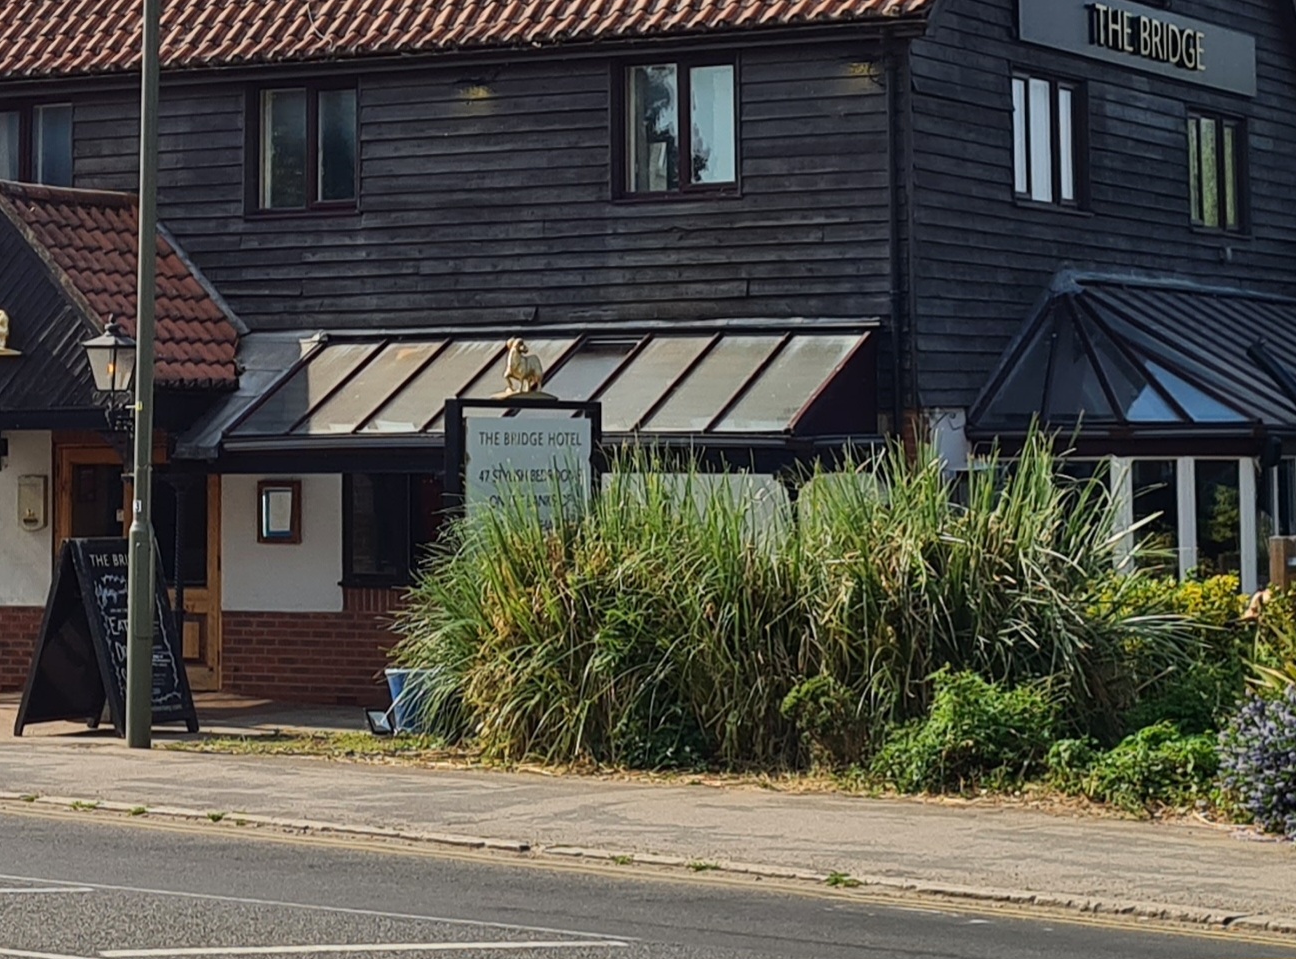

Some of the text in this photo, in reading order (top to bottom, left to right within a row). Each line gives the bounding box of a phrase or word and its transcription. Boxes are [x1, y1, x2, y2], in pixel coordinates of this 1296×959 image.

[1094, 2, 1206, 71] THE BRIDGE
[479, 431, 582, 447] THE BRIDGE HOTEL
[479, 469, 490, 483] 47
[89, 553, 110, 567] THE
